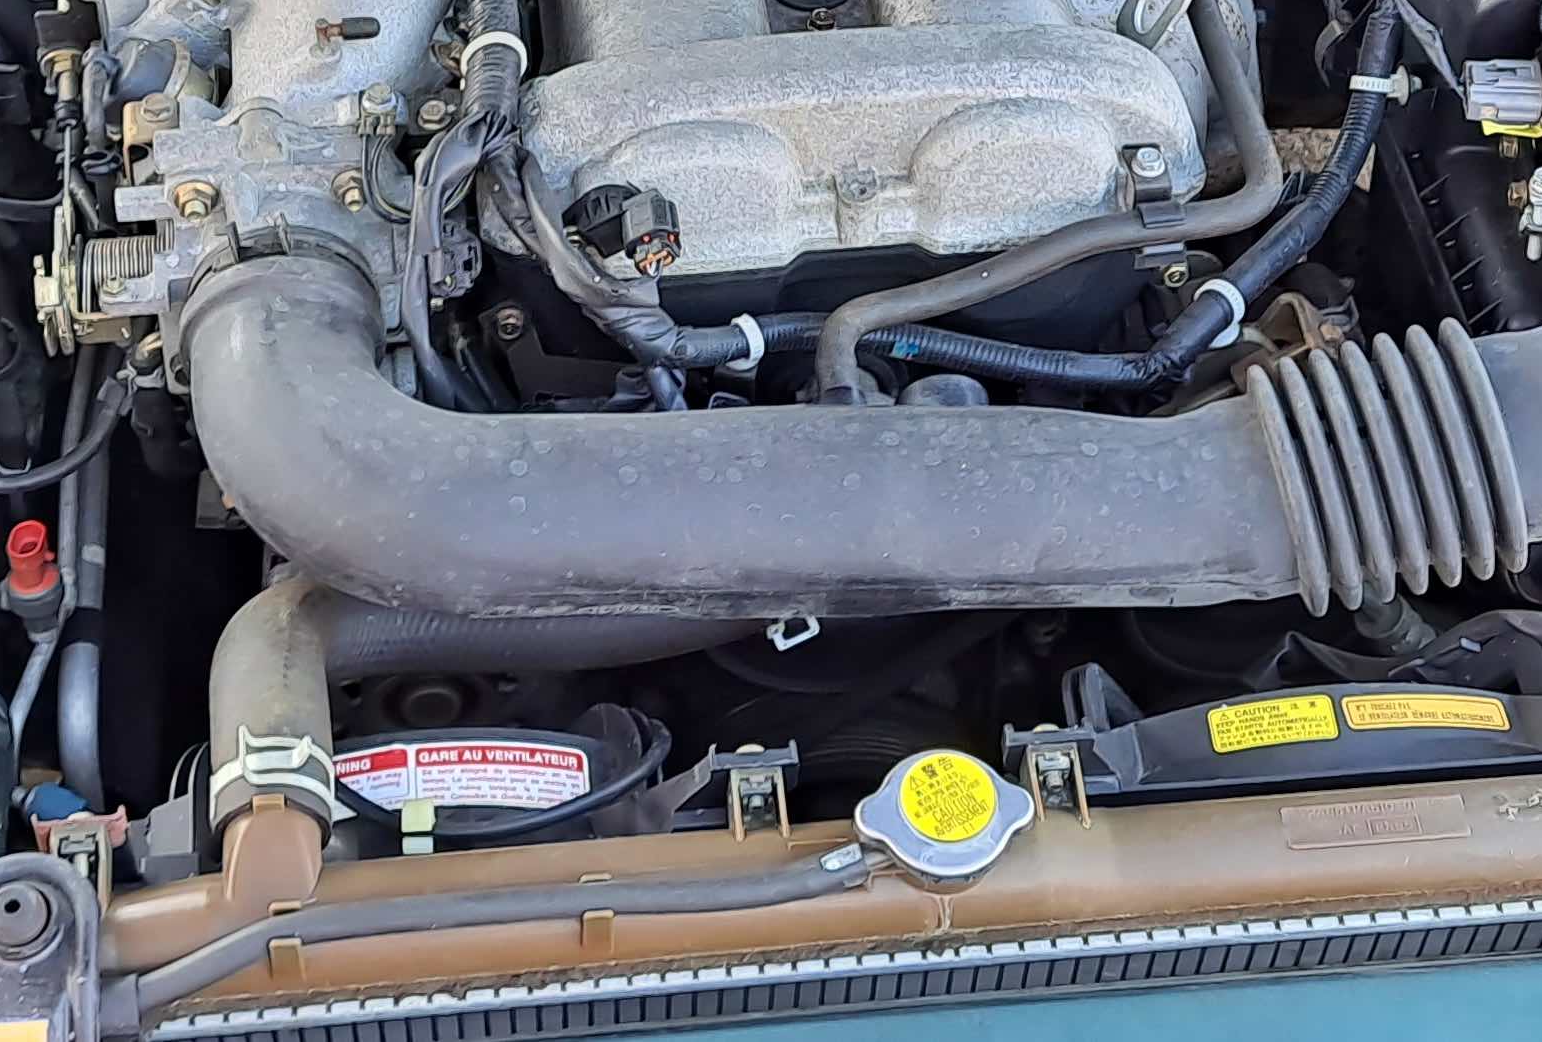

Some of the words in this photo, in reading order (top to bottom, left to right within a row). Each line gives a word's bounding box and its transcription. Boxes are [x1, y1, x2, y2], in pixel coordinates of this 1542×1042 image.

[1234, 705, 1280, 718] CAUTION
[419, 749, 460, 763] GARE
[462, 749, 482, 761] AU
[485, 749, 578, 767] VENTILATEUR
